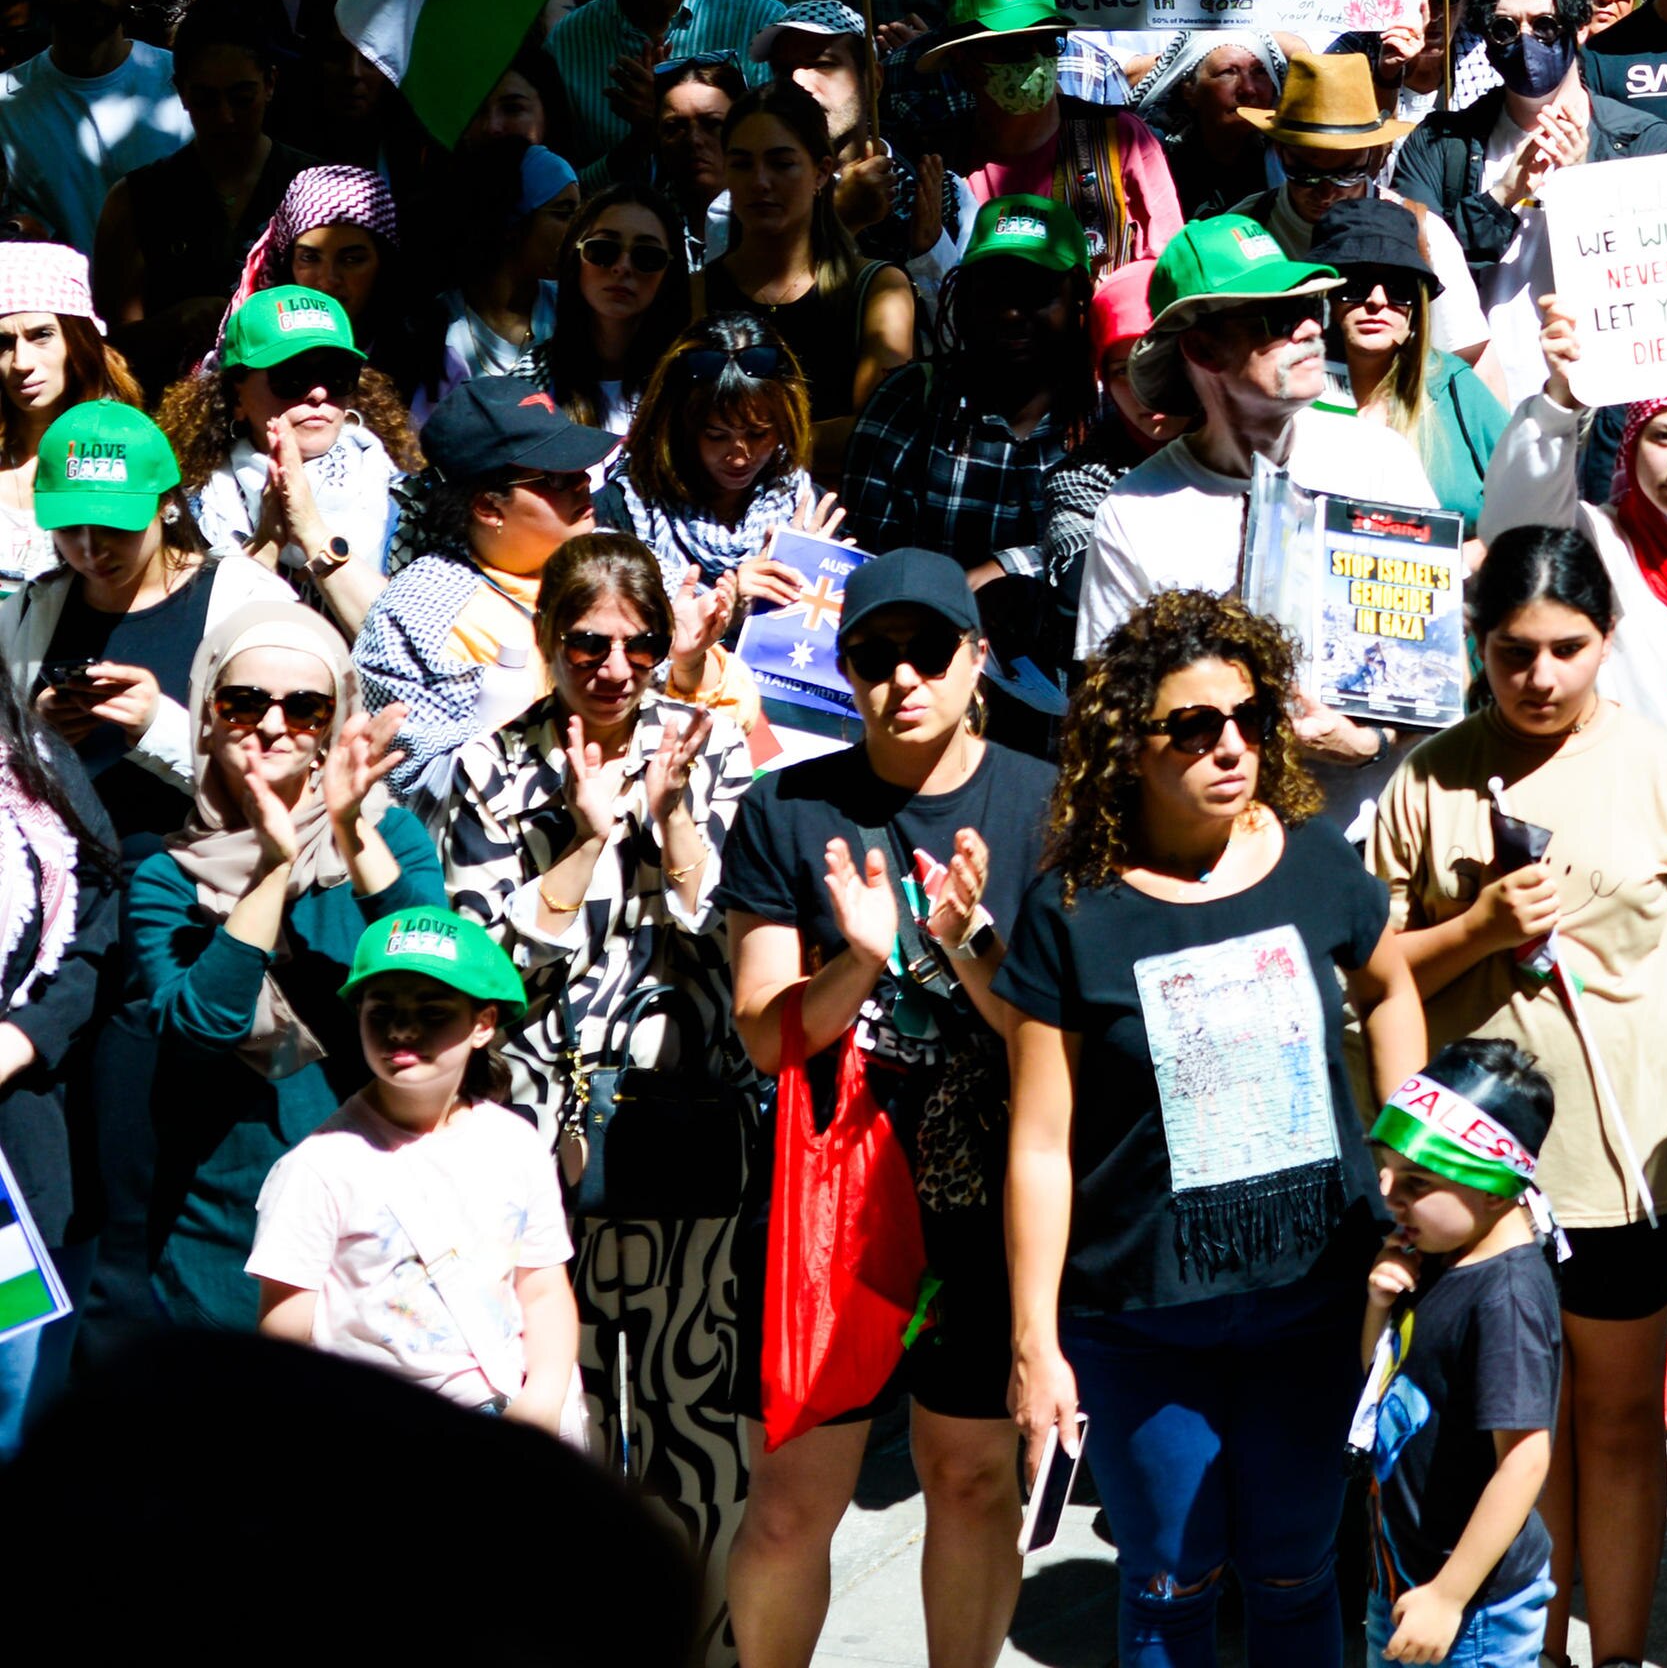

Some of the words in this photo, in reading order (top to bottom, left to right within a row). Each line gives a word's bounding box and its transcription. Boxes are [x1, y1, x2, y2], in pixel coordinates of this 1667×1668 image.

[1180, 17, 1222, 25] Palestinians
[995, 218, 1047, 239] GAZA
[1577, 229, 1617, 257] WE
[289, 297, 329, 314] LOVE
[1595, 301, 1636, 332] LET
[1633, 336, 1667, 366] DIE
[67, 441, 75, 459] I
[81, 442, 127, 460] LOVE
[66, 459, 128, 482] GAZA
[1332, 550, 1376, 579] STOP
[1377, 557, 1451, 591] ISRAEL'S
[1349, 579, 1434, 615] GENOCIDE
[1355, 608, 1378, 635] IN
[1379, 613, 1425, 642] GAZA
[755, 670, 803, 692] STAND
[805, 684, 836, 701] with
[405, 918, 459, 941] LOVE
